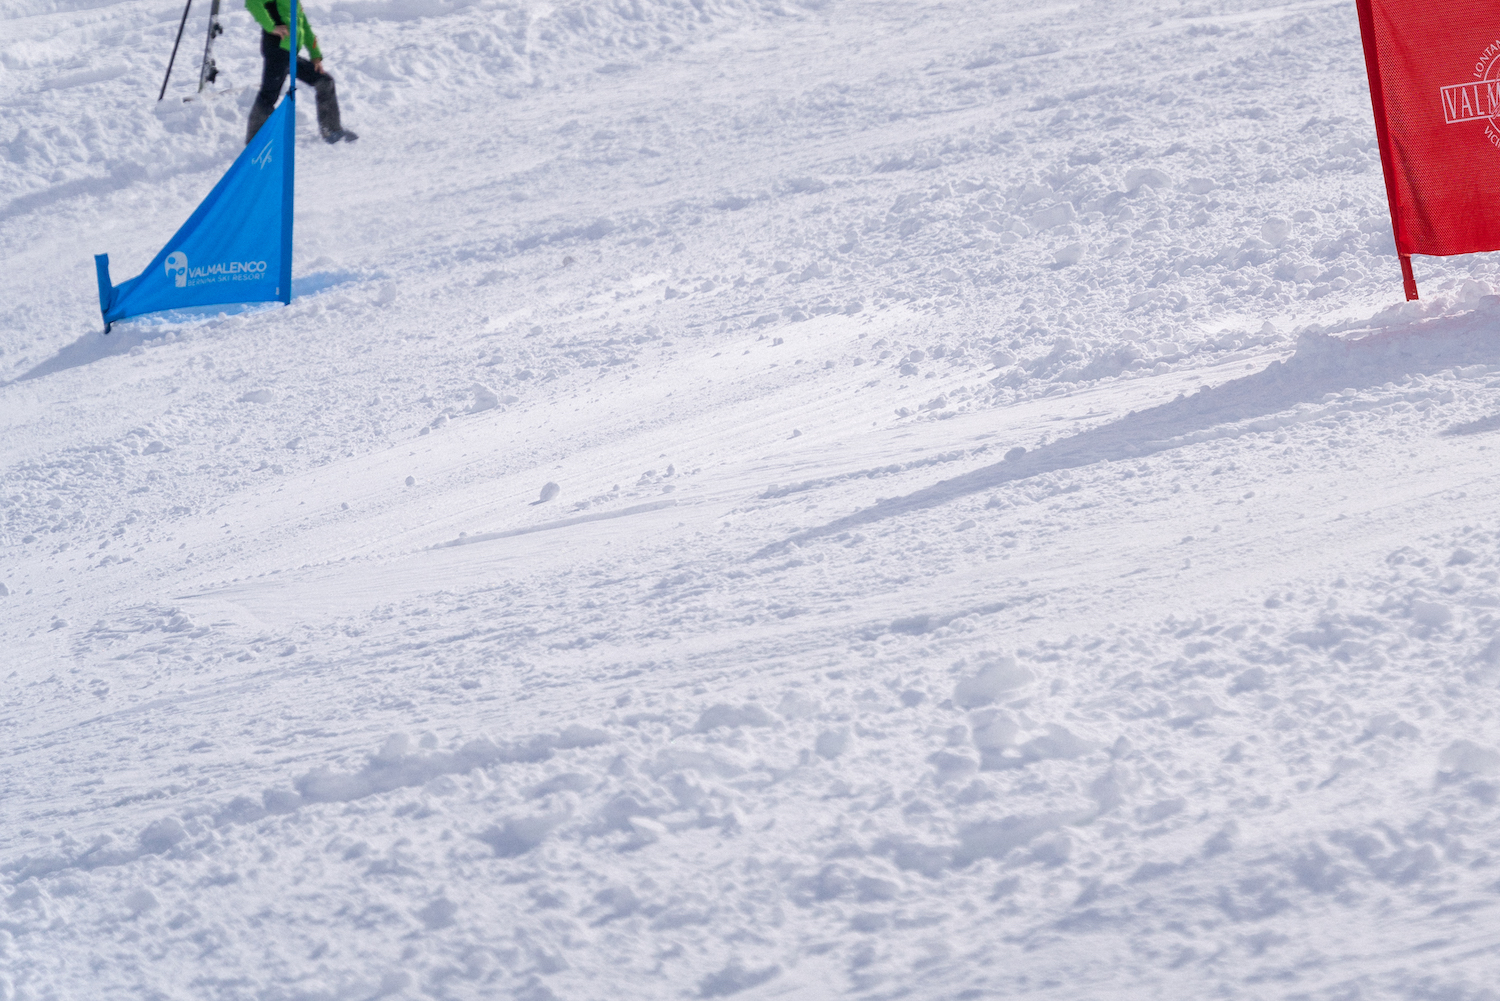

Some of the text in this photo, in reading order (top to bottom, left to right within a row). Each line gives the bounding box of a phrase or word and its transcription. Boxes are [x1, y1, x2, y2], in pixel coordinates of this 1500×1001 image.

[188, 261, 267, 278] VALMALENCO
[187, 272, 265, 286] BERNINA SKI RESORT
